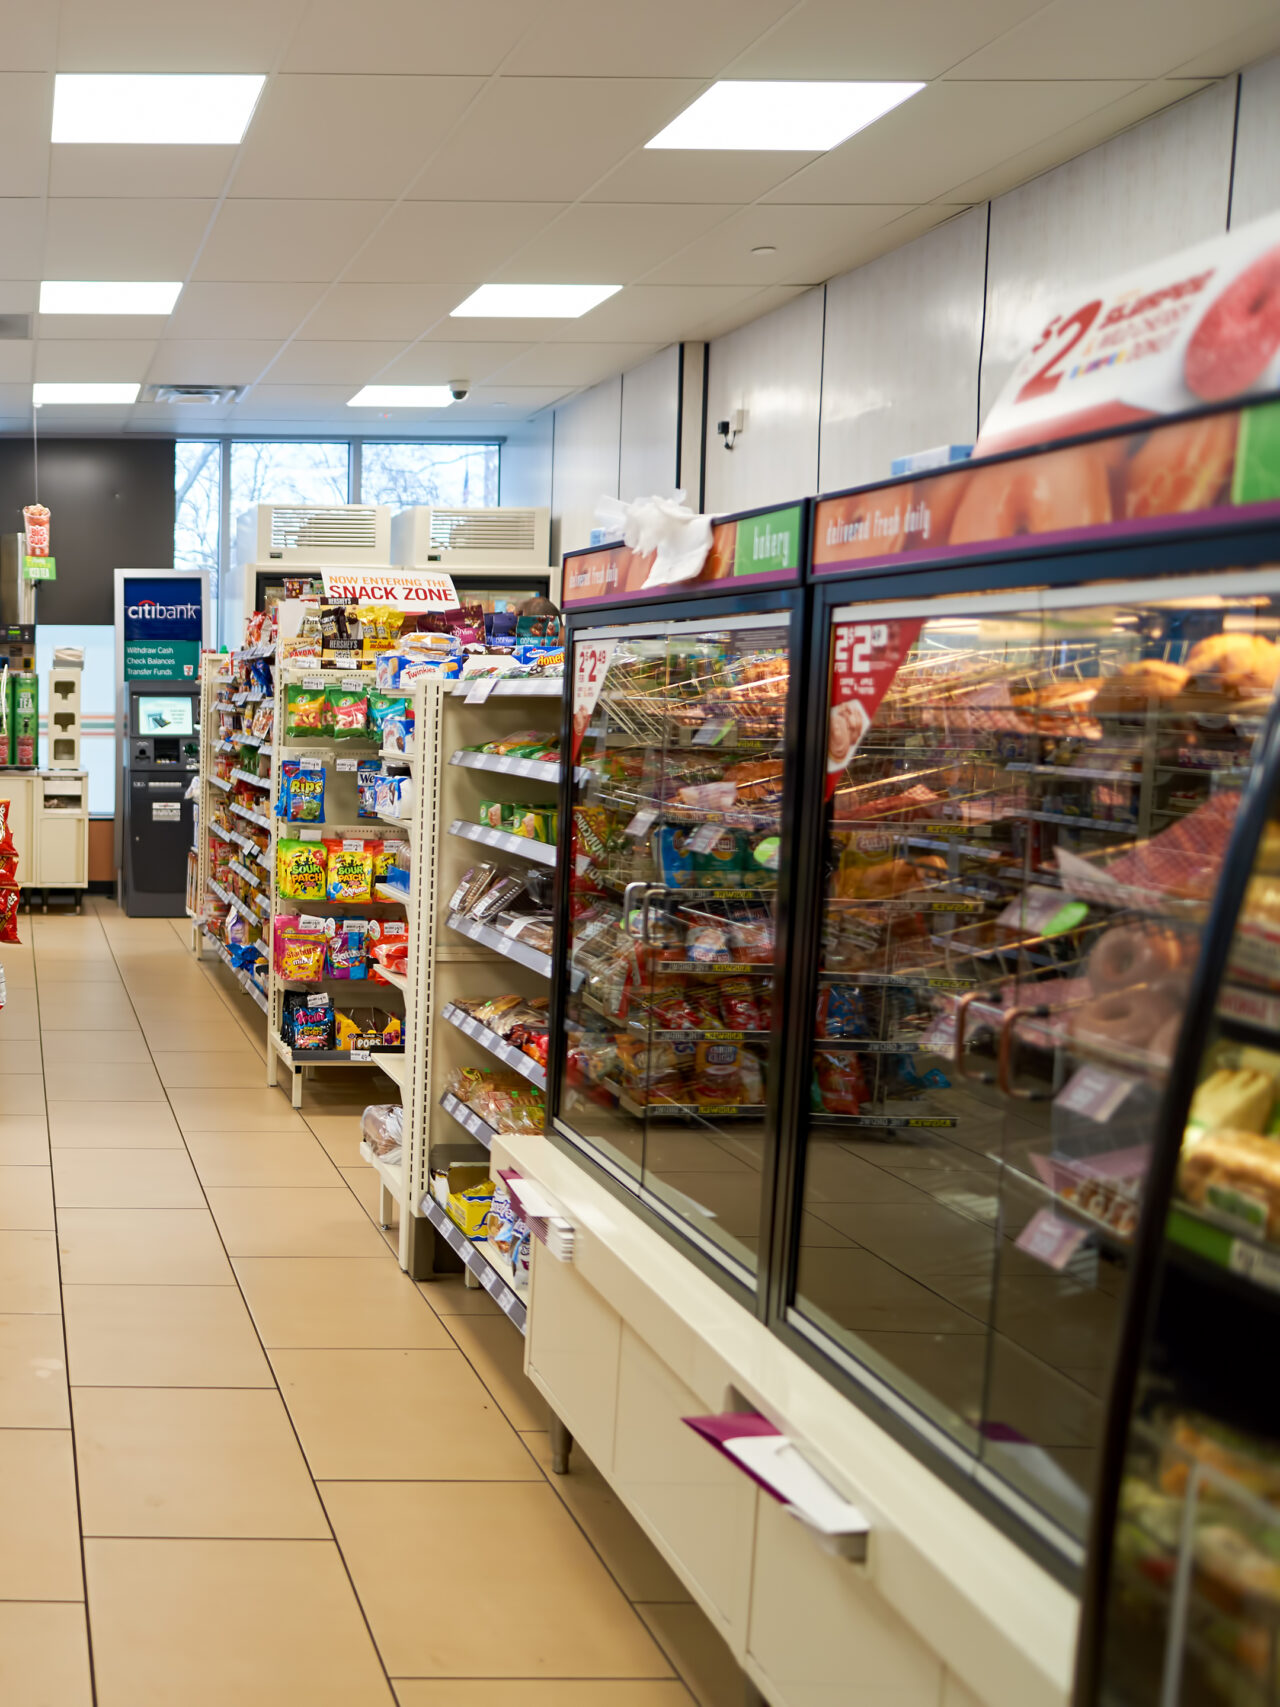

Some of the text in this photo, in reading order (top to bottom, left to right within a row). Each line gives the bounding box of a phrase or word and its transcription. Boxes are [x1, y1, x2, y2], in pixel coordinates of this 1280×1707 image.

[329, 576, 447, 588] NOW ENTERING THE
[329, 586, 455, 602] SNACK ZONE
[128, 602, 196, 619] citibank
[330, 640, 358, 649] HERSHEY'S
[127, 646, 174, 654] Withdraw Cash
[127, 668, 172, 676] Transfer Funds
[406, 668, 436, 680] Twinkies
[20, 698, 33, 708] TEA
[290, 779, 323, 794] Rips
[292, 865, 320, 874] SOUR
[338, 866, 364, 874] SOUR
[292, 873, 322, 882] PATCH
[357, 1039, 380, 1048] POPS
